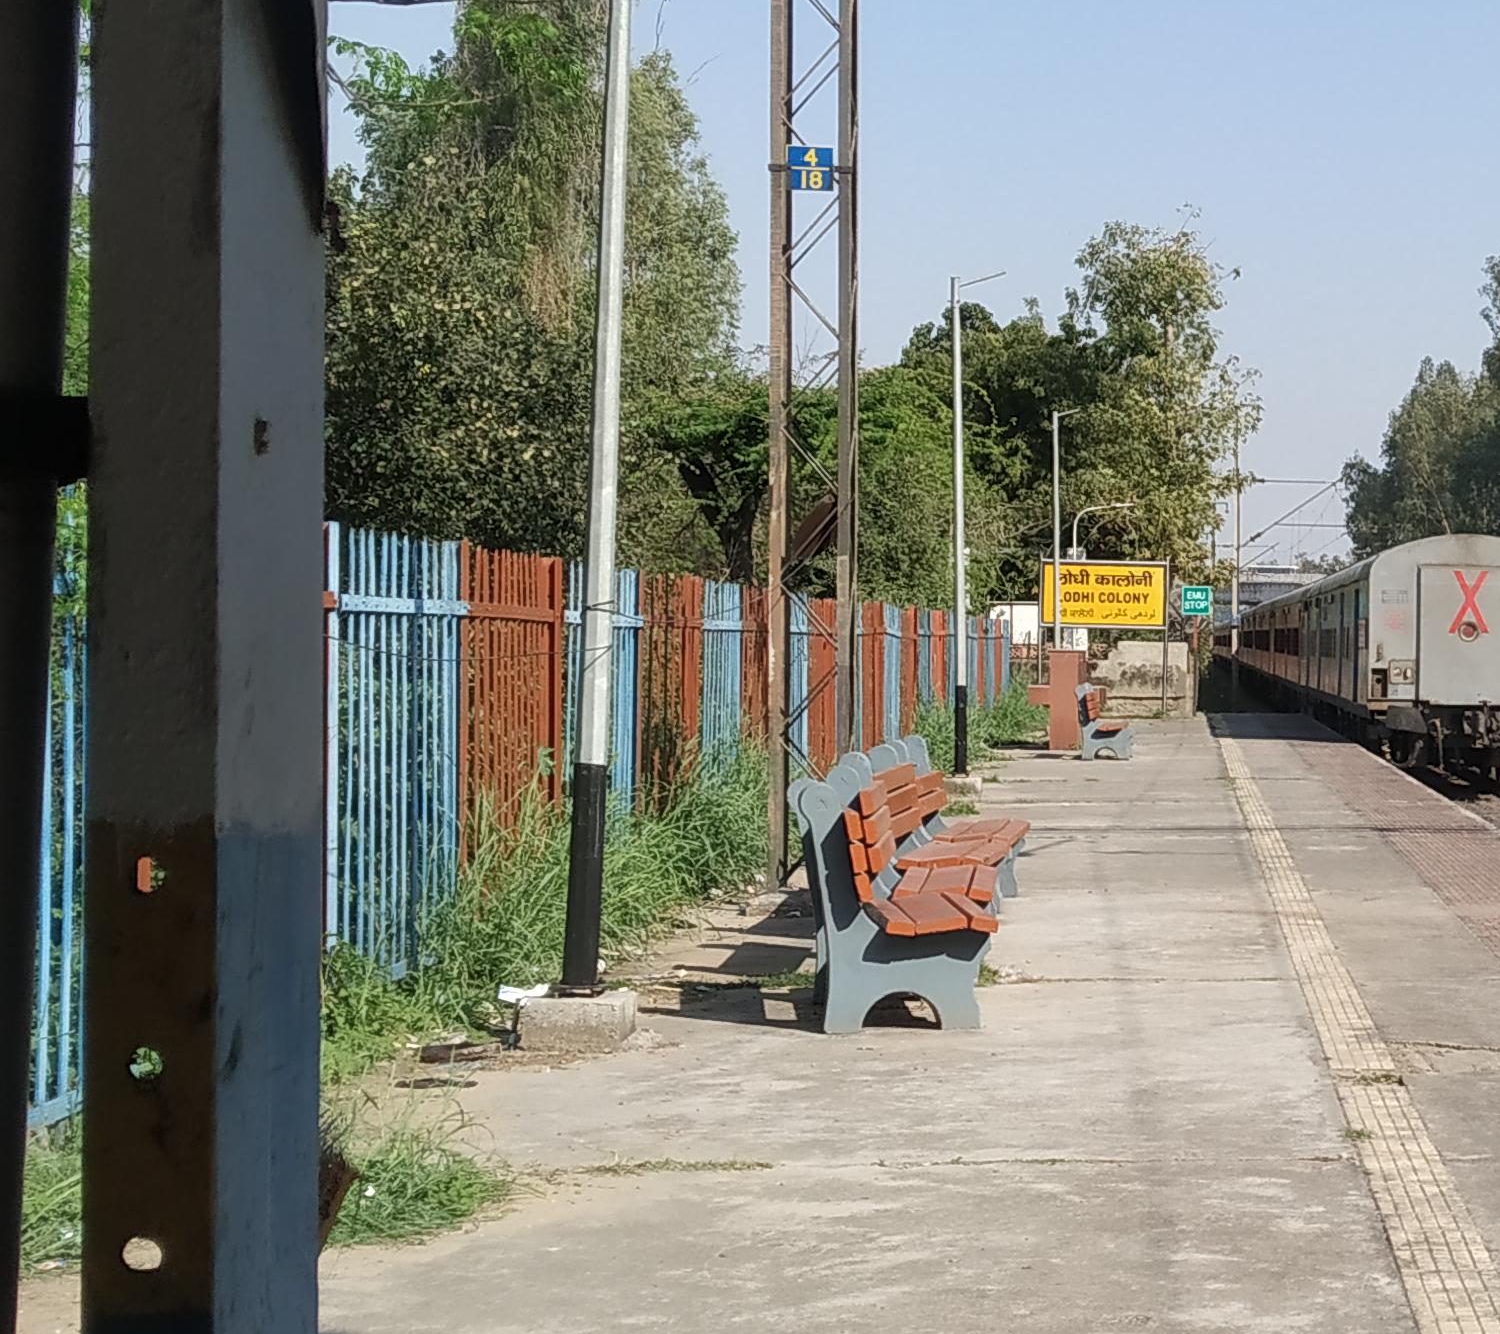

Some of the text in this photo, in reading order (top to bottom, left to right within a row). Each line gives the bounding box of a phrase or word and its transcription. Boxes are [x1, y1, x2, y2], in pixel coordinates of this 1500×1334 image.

[803, 148, 818, 167] 4
[801, 170, 823, 189] 18
[1094, 570, 1153, 587] कालोनी
[1059, 591, 1150, 604] ODHI COLONY
[1184, 601, 1208, 610] STOP
